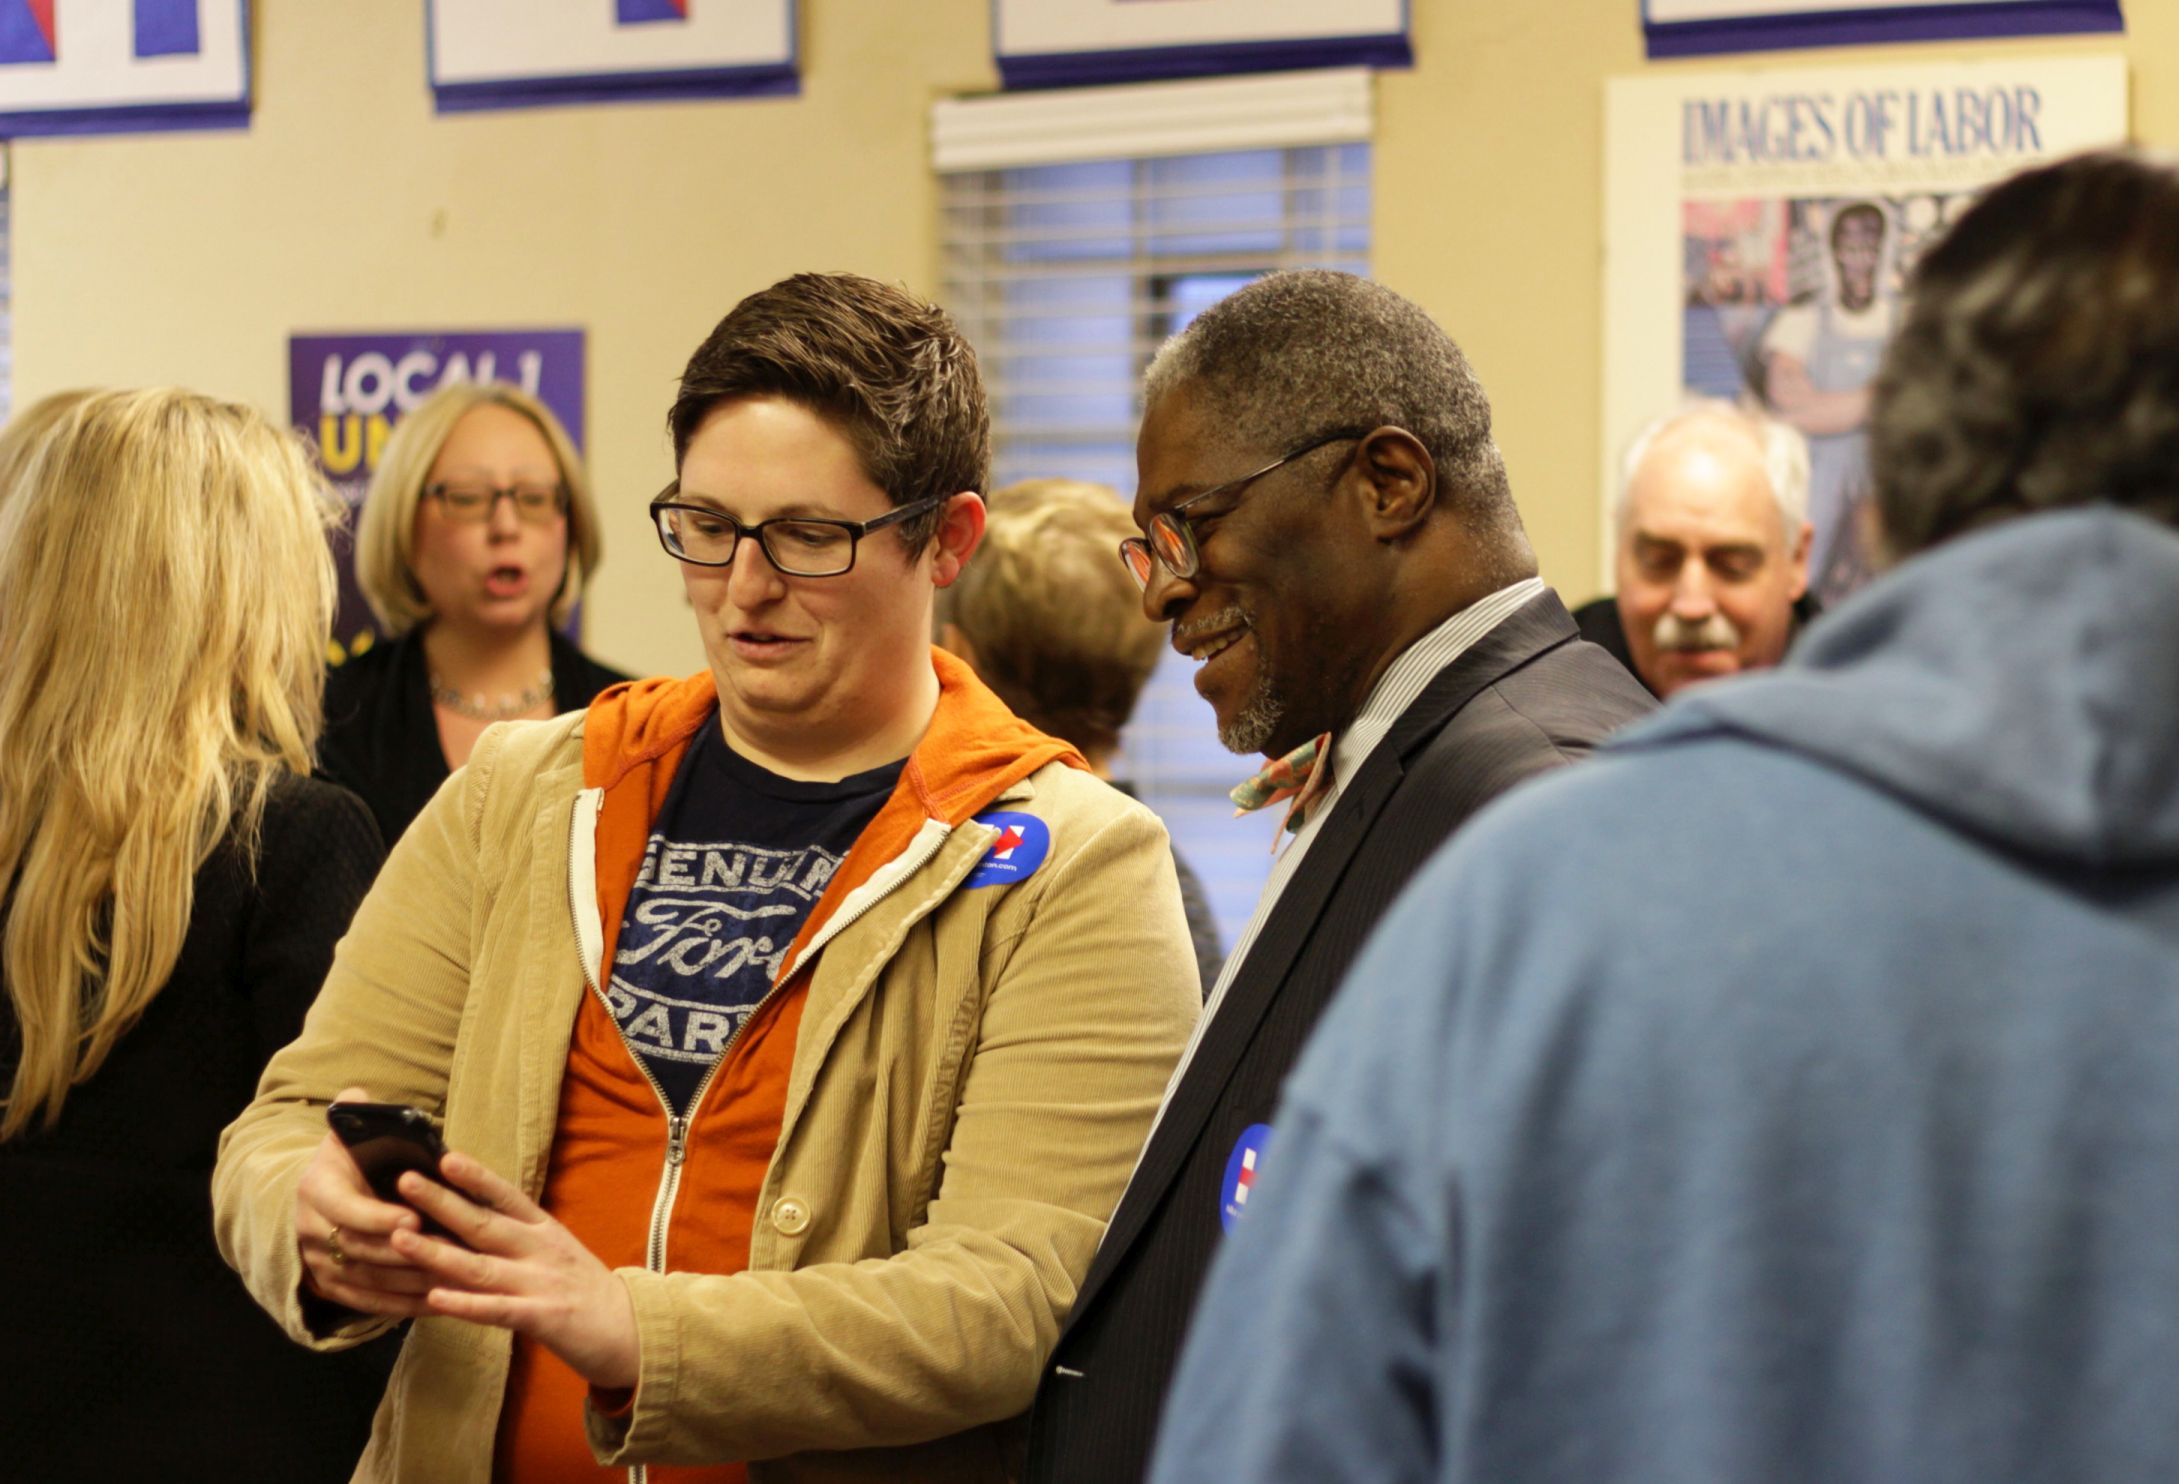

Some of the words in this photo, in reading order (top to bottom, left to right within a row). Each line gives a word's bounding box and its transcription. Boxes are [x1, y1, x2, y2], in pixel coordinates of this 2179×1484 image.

[1682, 94, 1835, 165] IMAGES
[1845, 88, 1901, 157] OF
[1908, 84, 2042, 155] LABOR
